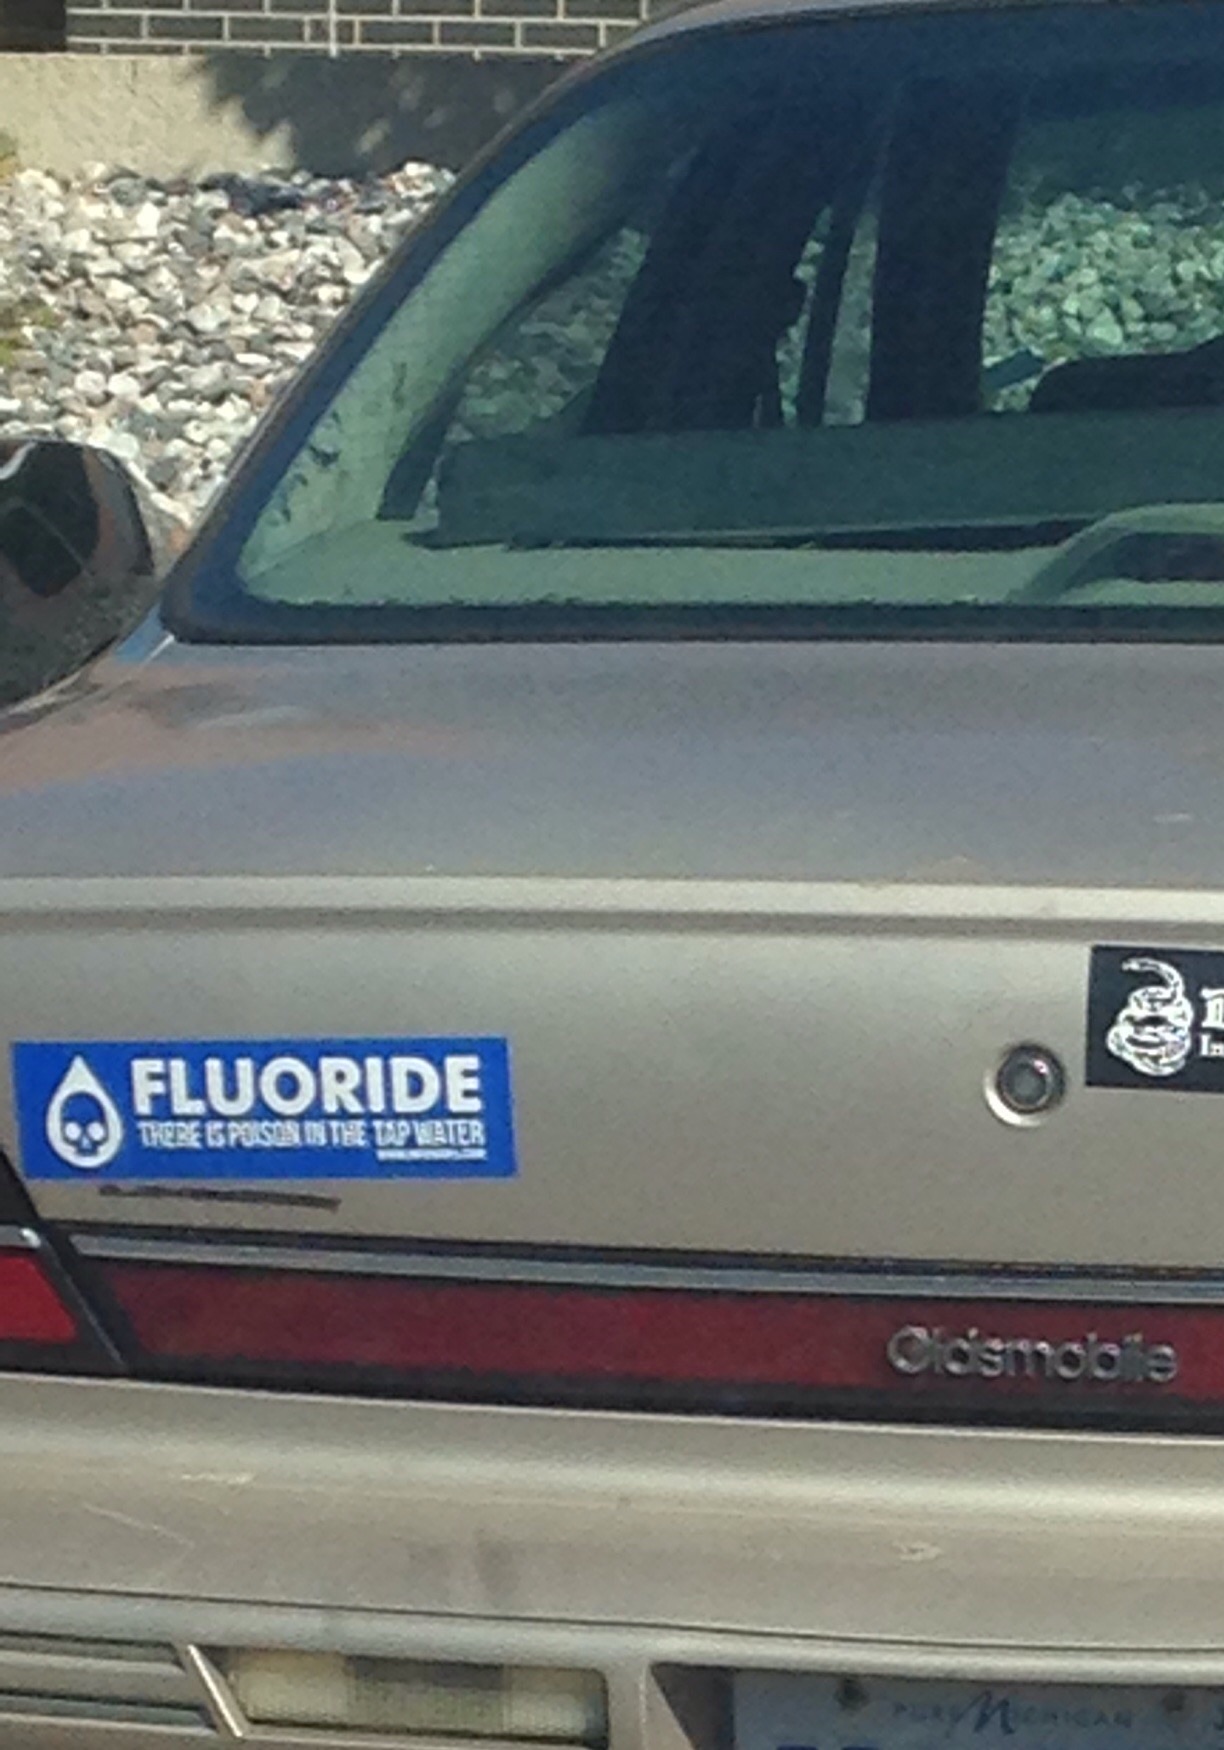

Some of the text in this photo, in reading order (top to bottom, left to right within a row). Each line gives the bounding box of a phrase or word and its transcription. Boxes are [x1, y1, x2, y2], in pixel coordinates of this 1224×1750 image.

[130, 1055, 484, 1117] FLUORIDE
[137, 1118, 487, 1149] THERE IS POISON IN THE TAP WATER
[887, 1324, 1178, 1383] Oldsmobile
